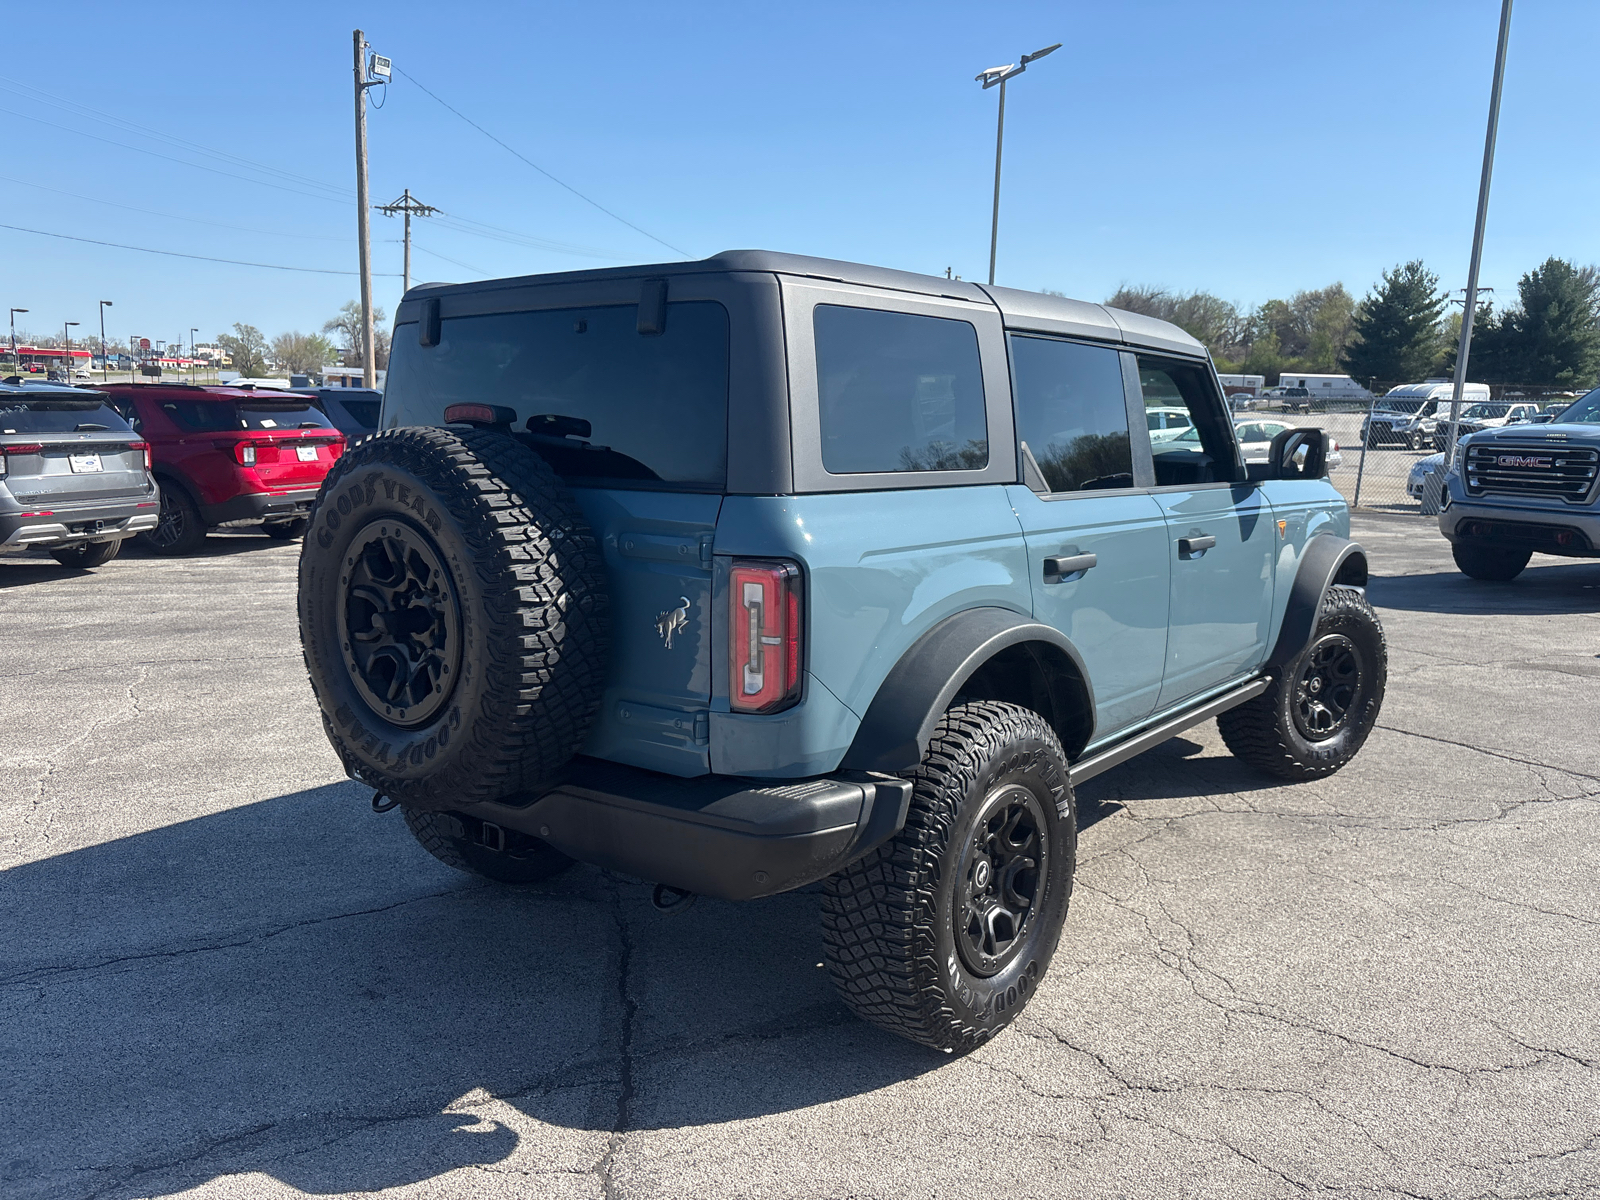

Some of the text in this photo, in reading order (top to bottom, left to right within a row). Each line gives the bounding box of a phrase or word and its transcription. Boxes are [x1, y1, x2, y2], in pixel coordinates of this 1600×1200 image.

[1498, 455, 1552, 468] GMC
[317, 472, 441, 549] GOODYEAR
[335, 702, 460, 773] GOODYEAR
[984, 748, 1070, 821] GOODYEAR
[948, 952, 1038, 1021] GOODYEAR
